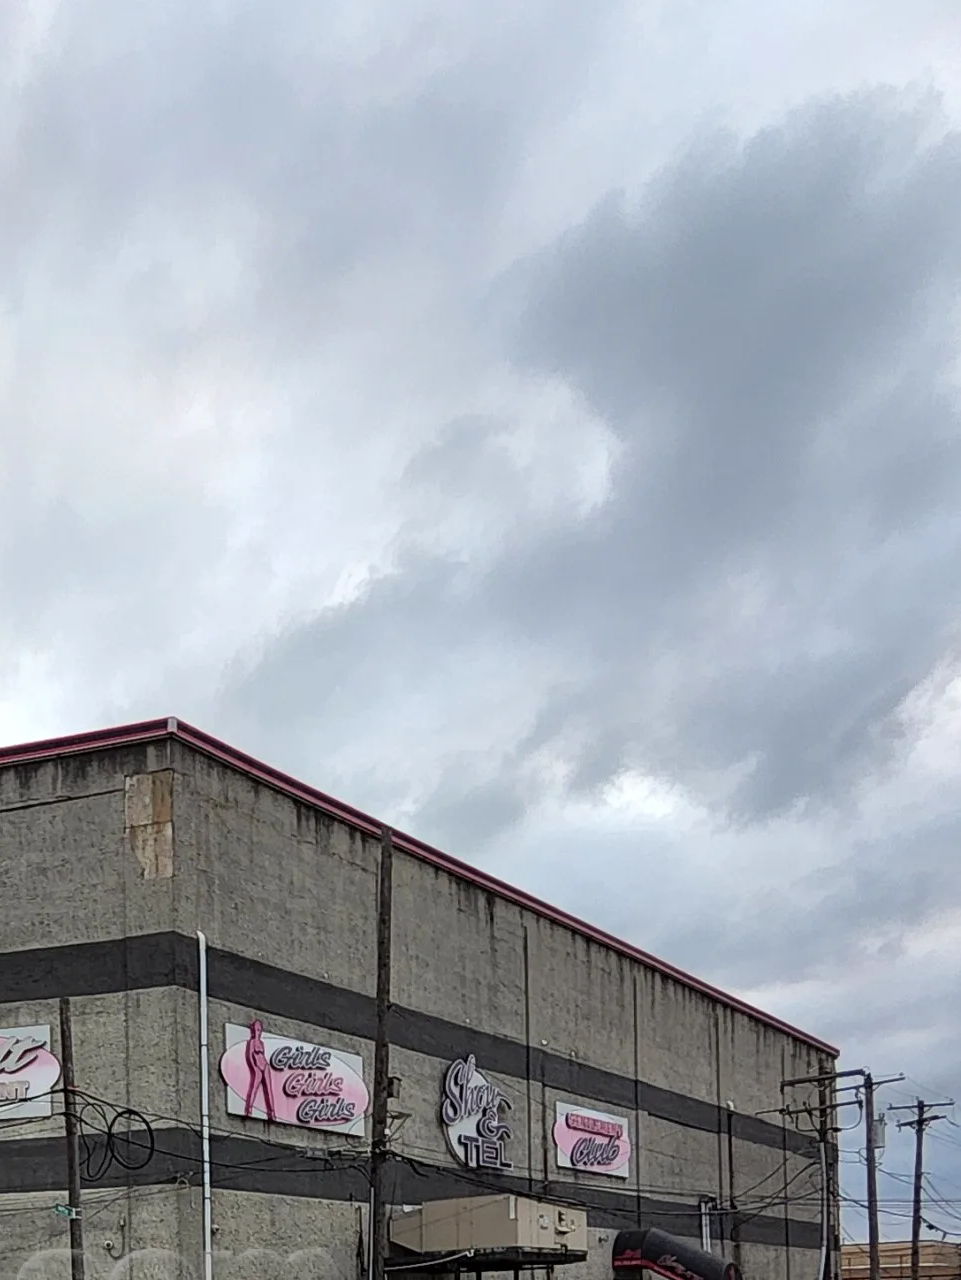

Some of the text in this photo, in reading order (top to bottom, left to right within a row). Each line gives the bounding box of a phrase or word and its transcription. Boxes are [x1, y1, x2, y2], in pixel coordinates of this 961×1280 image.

[269, 1046, 332, 1071] Girls
[283, 1072, 344, 1098] Girls
[442, 1054, 513, 1126] Show
[296, 1098, 356, 1124] Girls
[477, 1109, 513, 1139] &
[458, 1133, 513, 1171] TEL
[571, 1136, 620, 1167] Club
